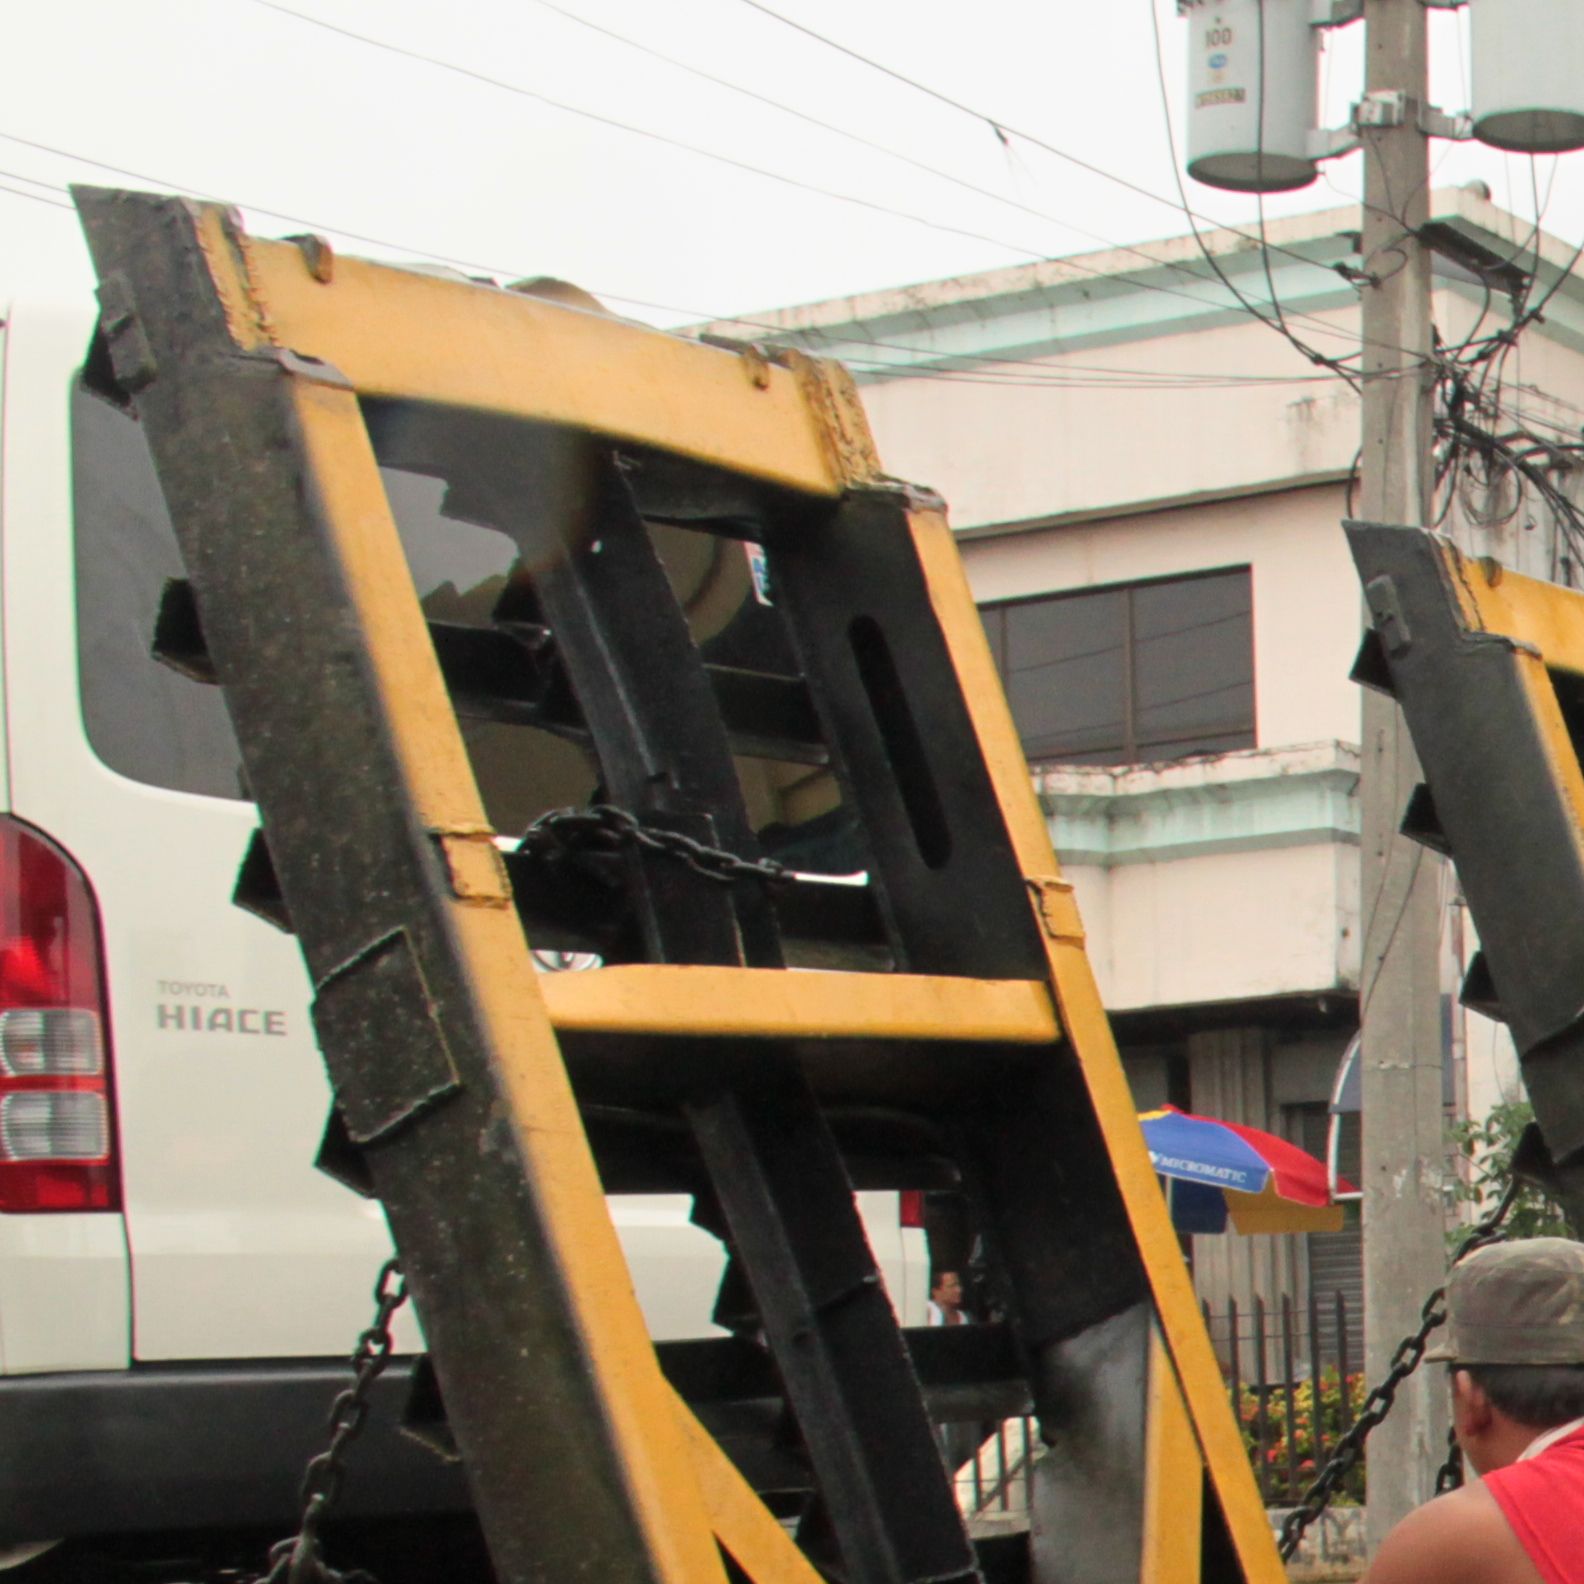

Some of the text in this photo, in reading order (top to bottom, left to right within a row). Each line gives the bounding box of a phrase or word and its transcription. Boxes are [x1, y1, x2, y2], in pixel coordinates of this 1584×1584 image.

[1205, 27, 1232, 48] 100
[157, 979, 230, 999] TOYOTA
[157, 1003, 288, 1037] HIACE
[1160, 1155, 1247, 1184] MICROMATIC
